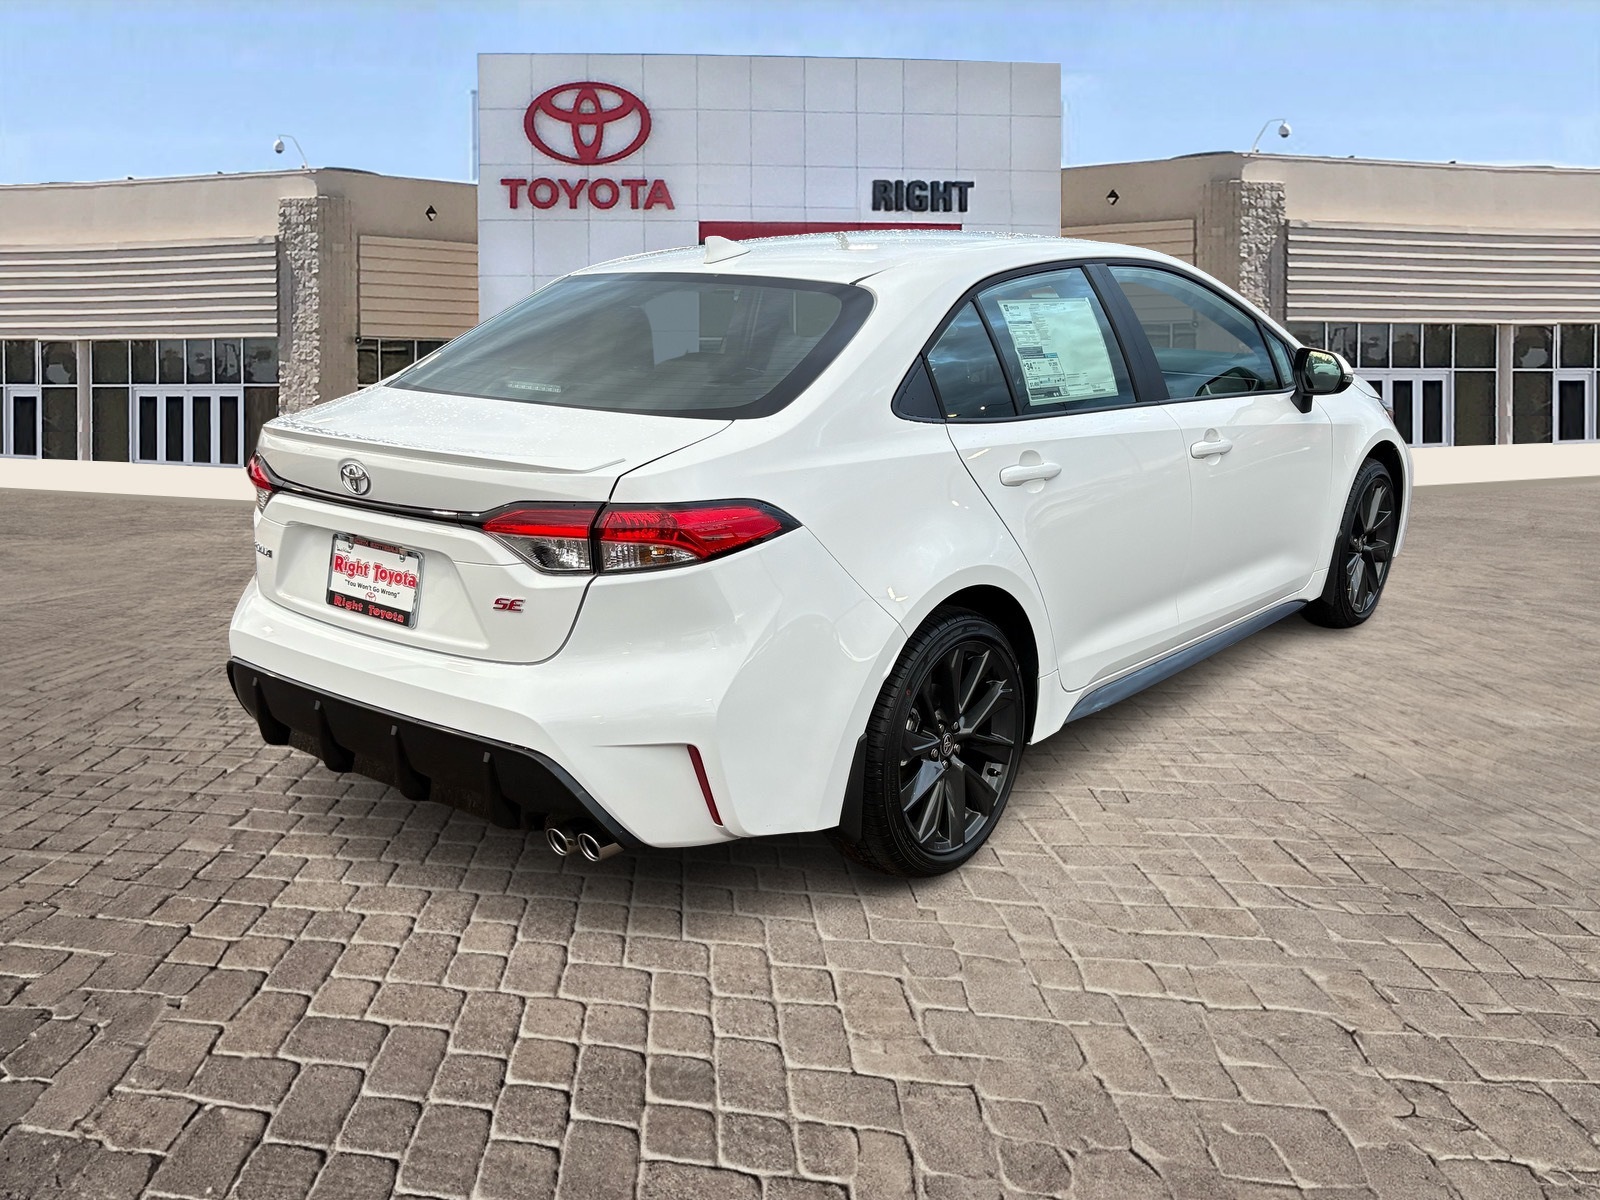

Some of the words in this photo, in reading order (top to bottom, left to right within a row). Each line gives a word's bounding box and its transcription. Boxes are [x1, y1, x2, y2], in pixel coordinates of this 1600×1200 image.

[500, 177, 675, 210] TOYOTA
[872, 179, 975, 212] RIGHT
[333, 552, 370, 579] Right
[373, 562, 417, 588] Toyota
[357, 582, 372, 591] Won't
[333, 594, 363, 611] Right
[368, 604, 405, 623] Toyota
[493, 597, 525, 613] SE
